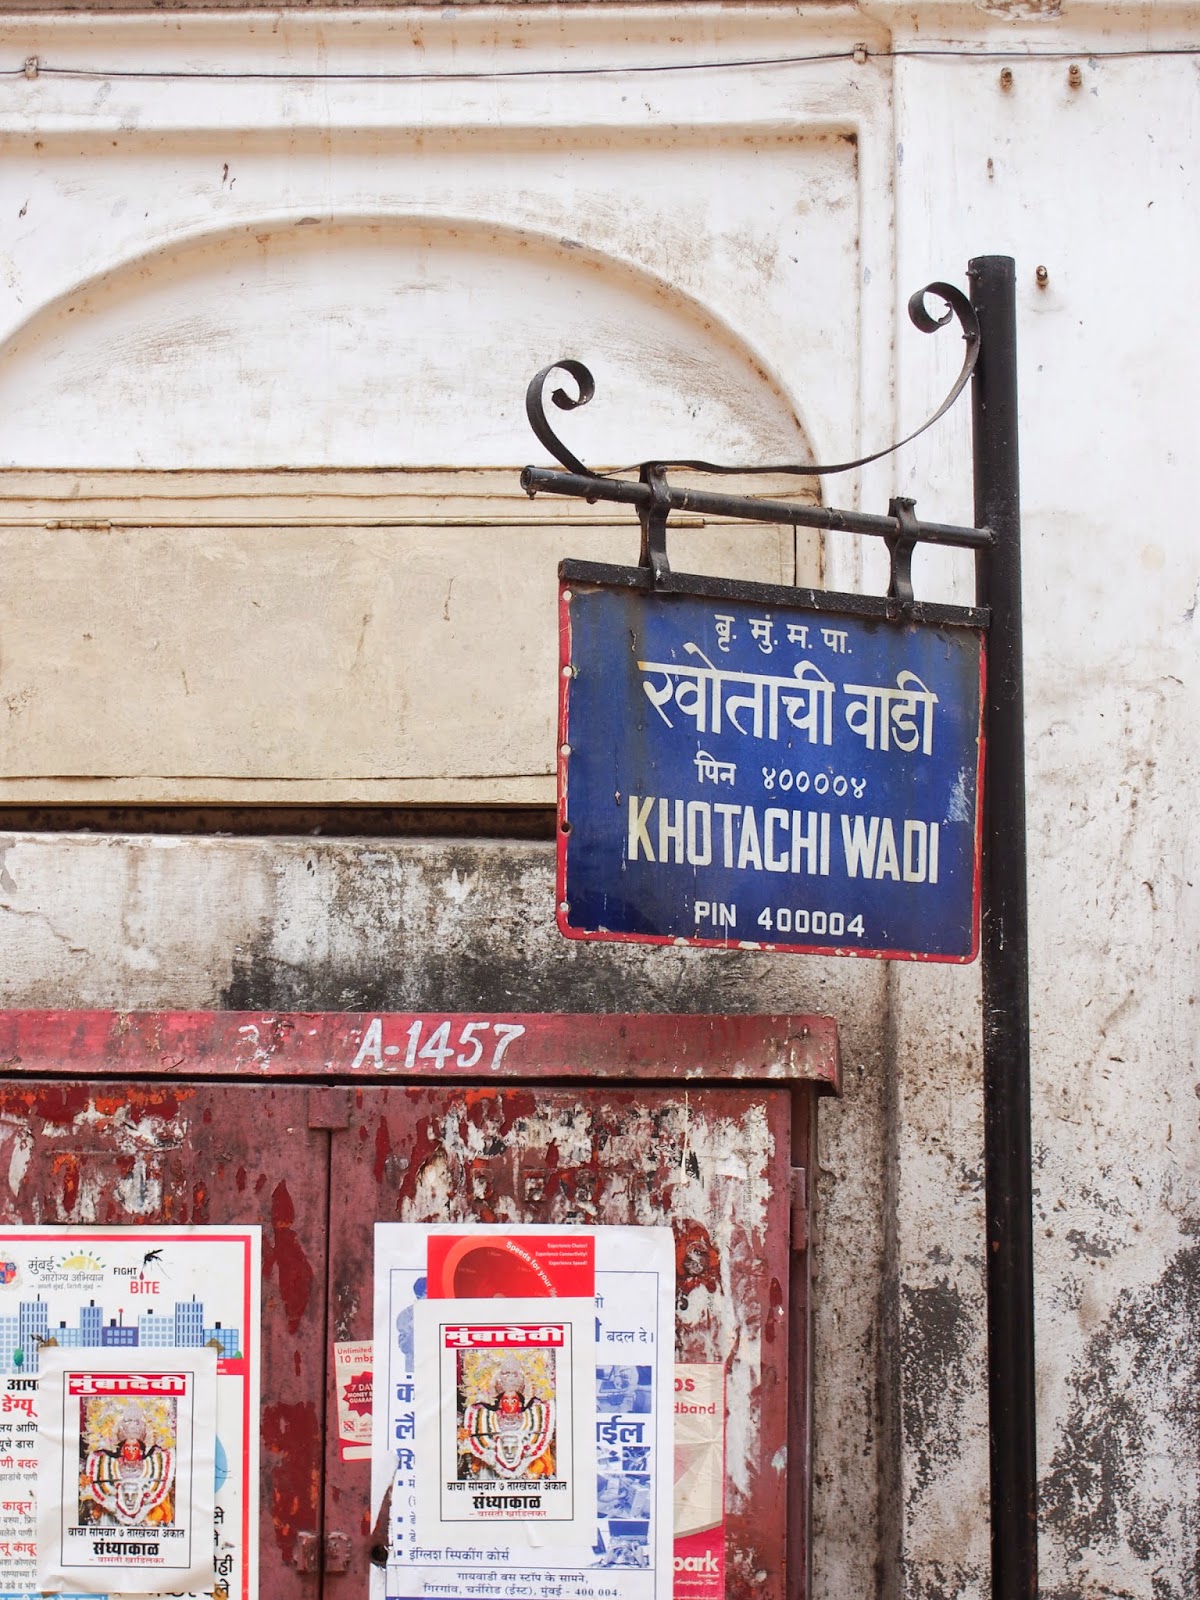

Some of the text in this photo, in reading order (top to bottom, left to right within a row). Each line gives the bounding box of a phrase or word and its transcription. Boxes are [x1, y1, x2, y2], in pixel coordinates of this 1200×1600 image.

[748, 614, 778, 654] मुं.
[786, 624, 813, 649] म.
[820, 628, 852, 654] पा.
[637, 642, 940, 756] खोताची वाडी
[694, 751, 867, 799] पिन ४००००४
[628, 795, 939, 884] KHOTACHI WADI
[694, 901, 865, 937] PIN 400004
[351, 1018, 525, 1070] A-1457
[28, 1256, 55, 1274] मुंबई
[113, 1267, 137, 1275] FIGHT
[506, 1241, 553, 1288] Speeds for your
[71, 1271, 104, 1282] अभियान
[130, 1281, 160, 1294] BITE
[606, 1331, 635, 1343] बदल
[338, 1347, 372, 1355] Unlimited
[339, 1355, 351, 1364] 10
[16, 1421, 38, 1433] आणि
[15, 1440, 34, 1449] डास
[447, 1481, 466, 1491] वाचा
[472, 1492, 542, 1509] संध्याकाळ
[68, 1527, 87, 1537] वाचा
[93, 1538, 160, 1555] संध्याकाळ
[409, 1547, 442, 1560] इंग्लिश
[486, 1547, 510, 1560] कोर्स
[456, 1571, 498, 1581] गायवाडी
[519, 1571, 541, 1582] स्टॉप
[545, 1571, 556, 1582] के
[540, 1584, 562, 1598] मुंबई
[574, 1588, 594, 1597] 400
